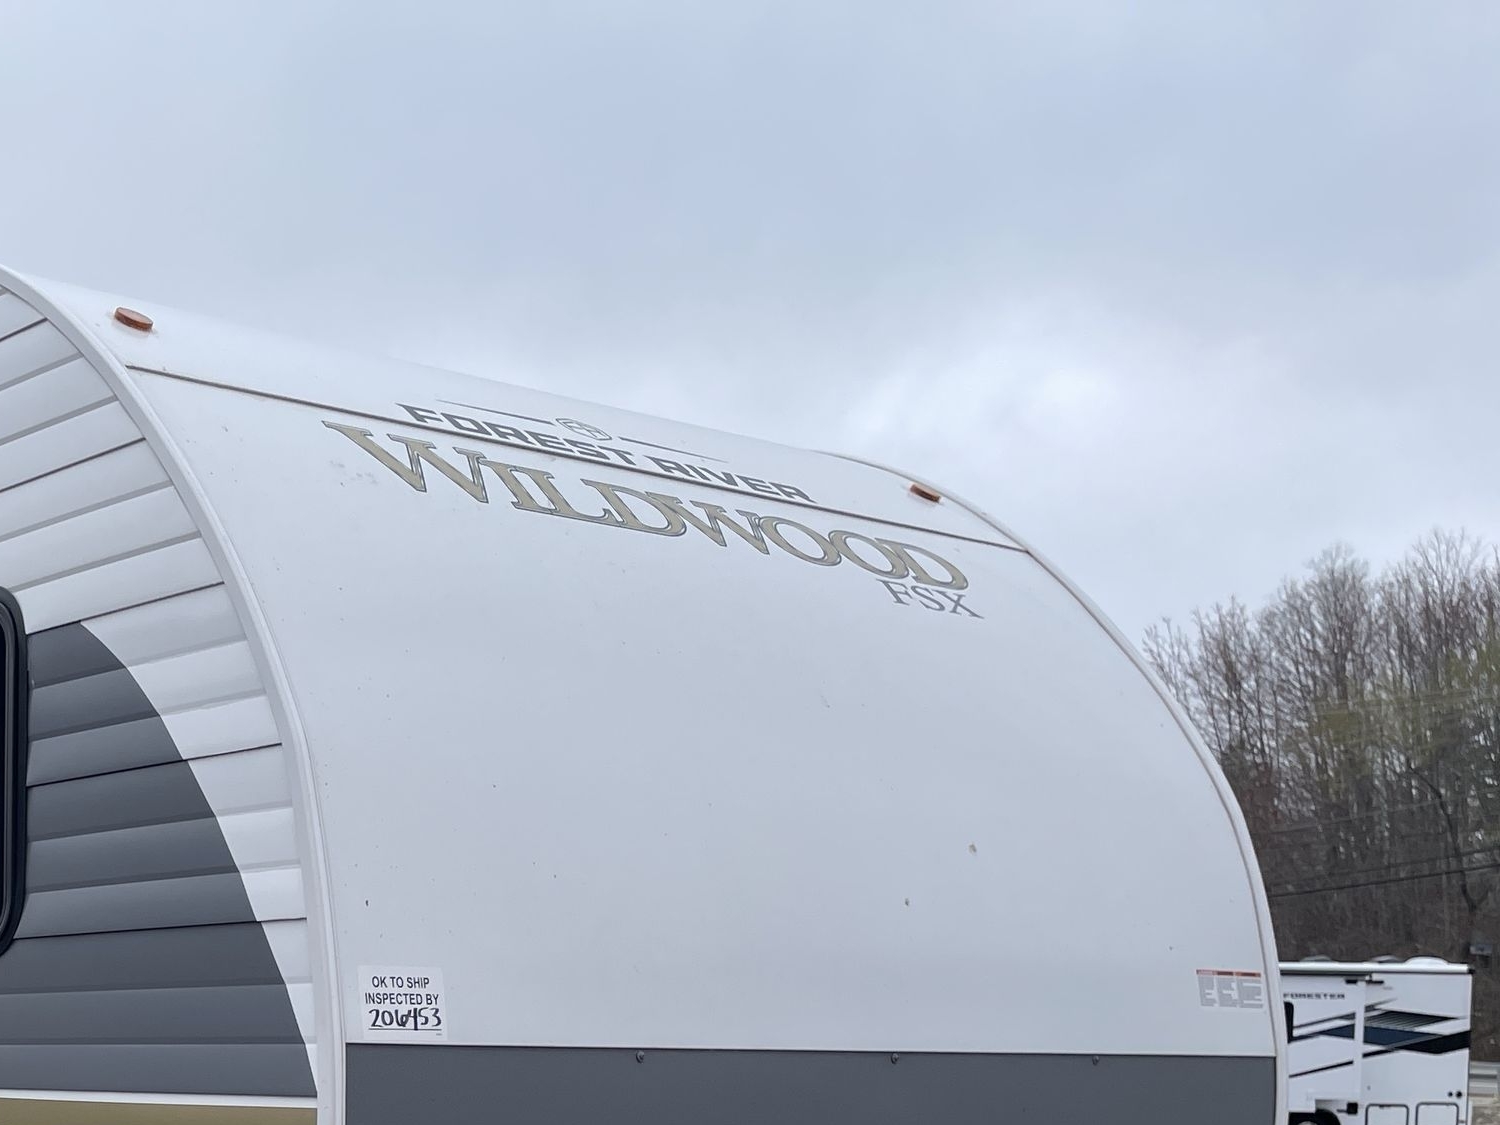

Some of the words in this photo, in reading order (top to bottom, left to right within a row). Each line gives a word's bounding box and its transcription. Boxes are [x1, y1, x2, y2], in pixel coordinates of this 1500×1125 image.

[396, 403, 637, 465] FOREST
[644, 455, 818, 504] RIVER
[321, 420, 969, 590] WILDWOOD
[876, 579, 985, 619] FSX
[365, 992, 423, 1005] INSPECTED
[425, 993, 440, 1005] BY
[371, 976, 388, 988] OK
[390, 976, 404, 988] TO
[406, 977, 430, 989] SHIP
[368, 1007, 442, 1031] 206453
